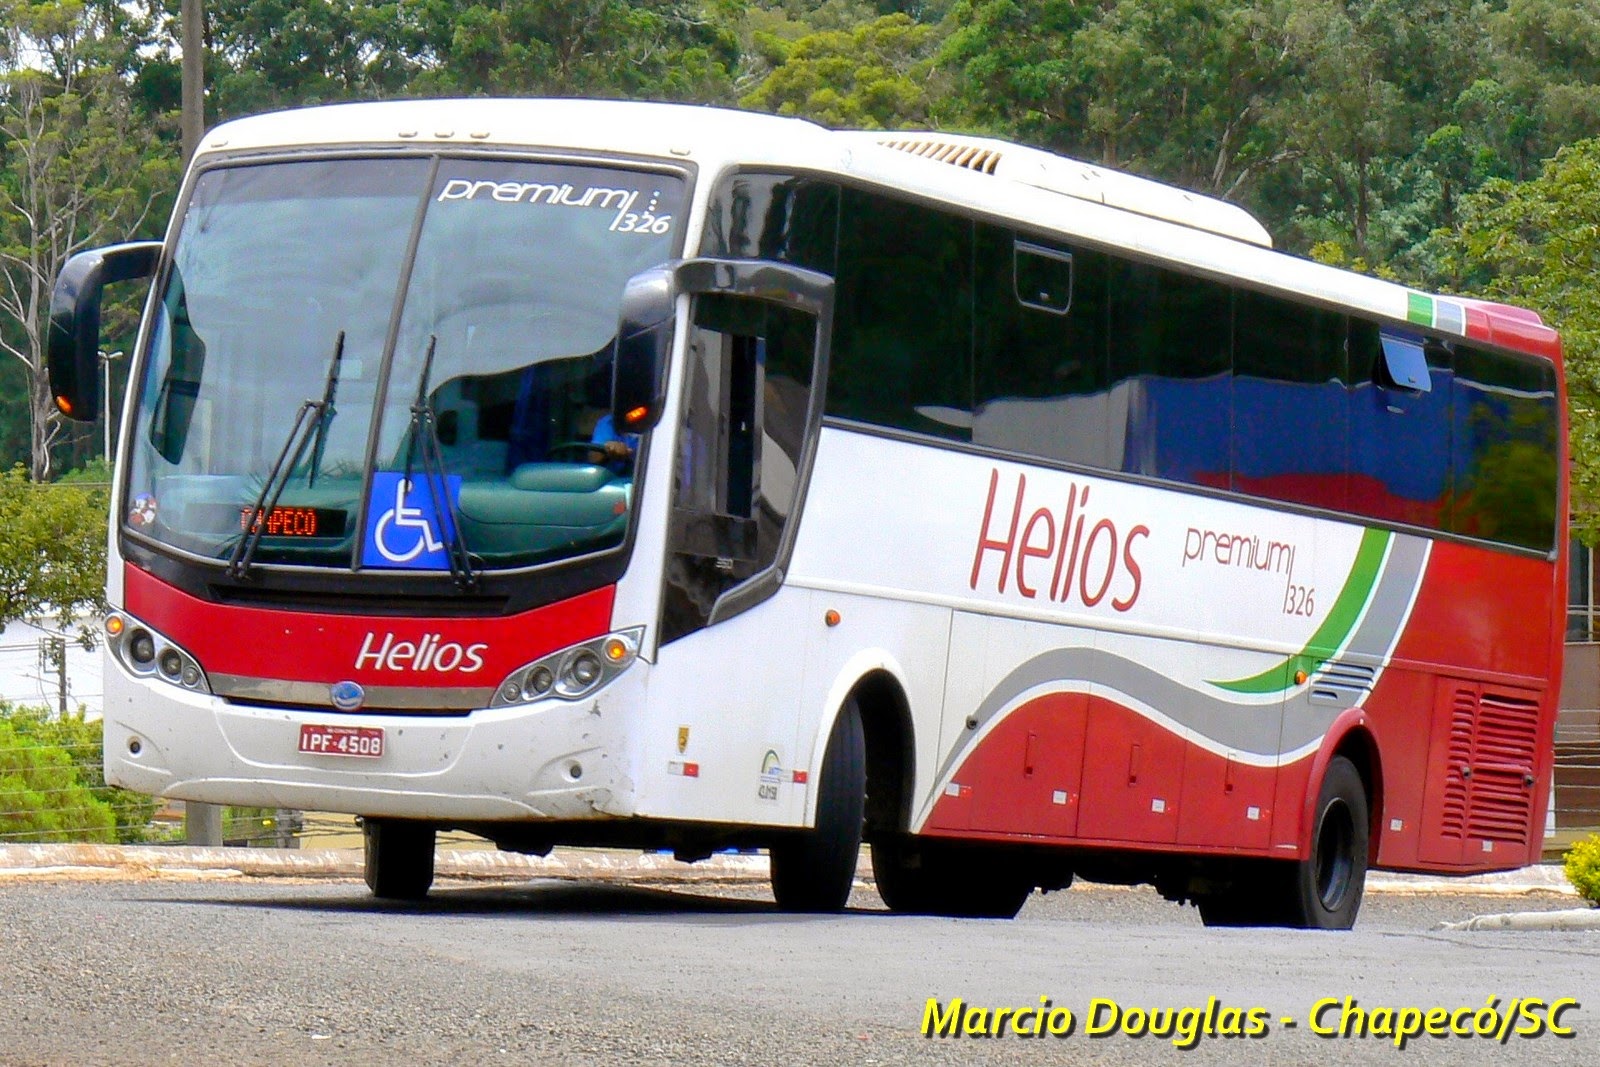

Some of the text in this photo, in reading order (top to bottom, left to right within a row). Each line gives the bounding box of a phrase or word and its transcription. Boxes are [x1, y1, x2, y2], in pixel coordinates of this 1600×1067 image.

[437, 179, 632, 209] premium
[969, 467, 1150, 613] Helios
[1182, 527, 1292, 575] premium
[354, 631, 489, 673] Helios
